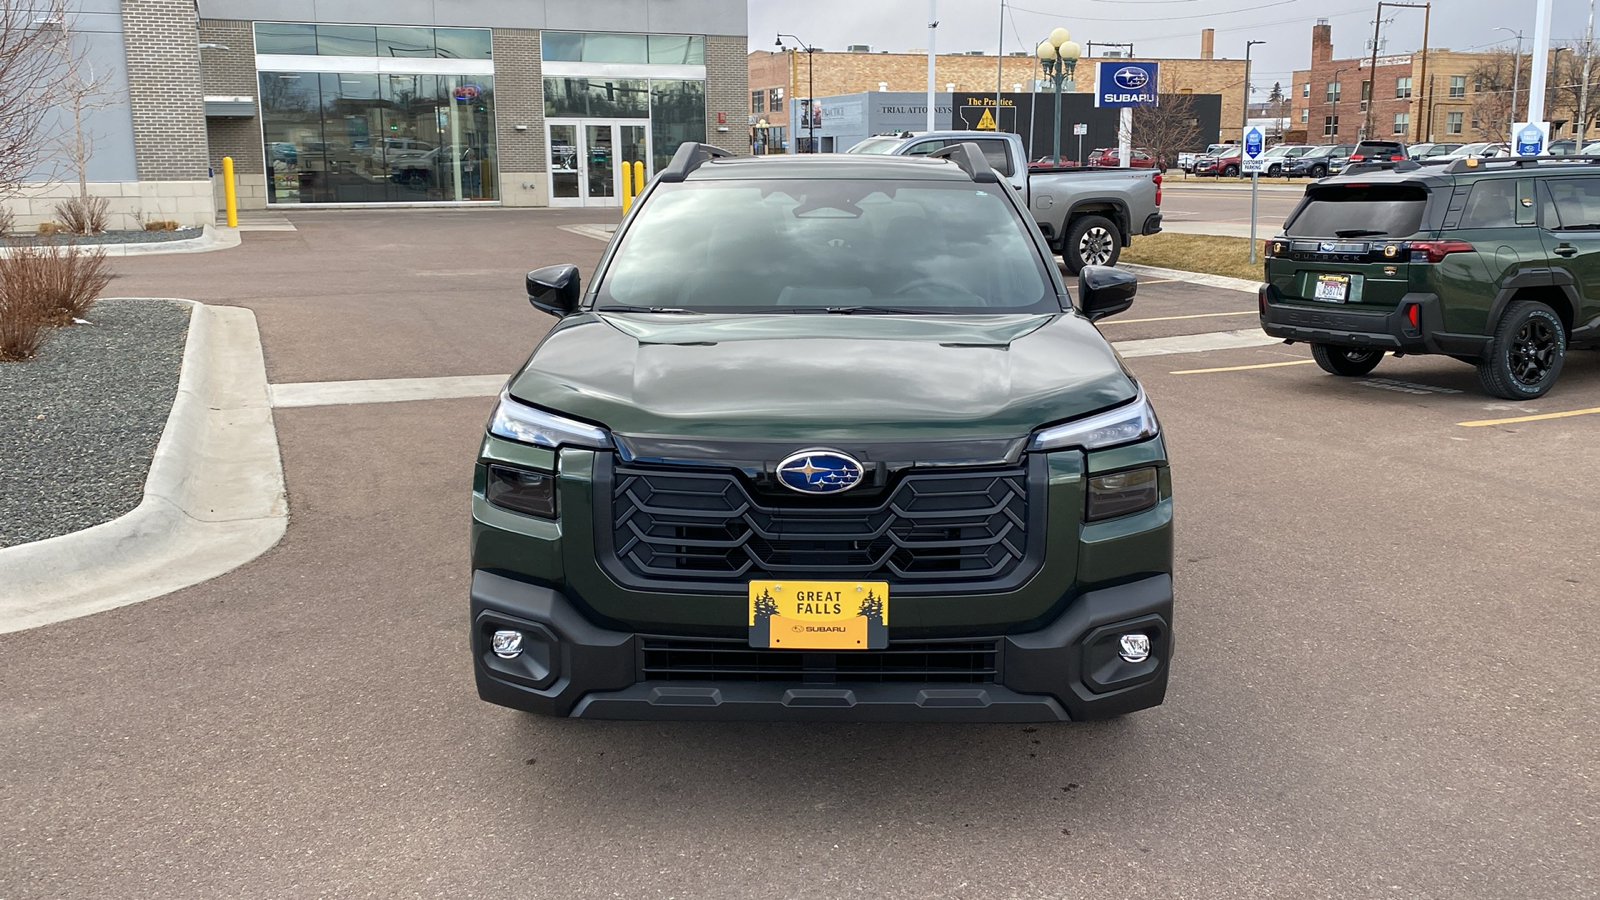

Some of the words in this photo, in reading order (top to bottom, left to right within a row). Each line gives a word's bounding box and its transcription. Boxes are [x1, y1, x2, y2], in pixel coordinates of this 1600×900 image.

[967, 97, 982, 106] The
[983, 97, 1013, 106] Pratice
[1104, 94, 1155, 103] SUBARU
[881, 106, 906, 114] TRIAL
[907, 106, 953, 114] ATTONEYS
[1294, 253, 1361, 261] OUTBACK
[797, 591, 841, 601] GREAT
[797, 603, 841, 614] FALLS
